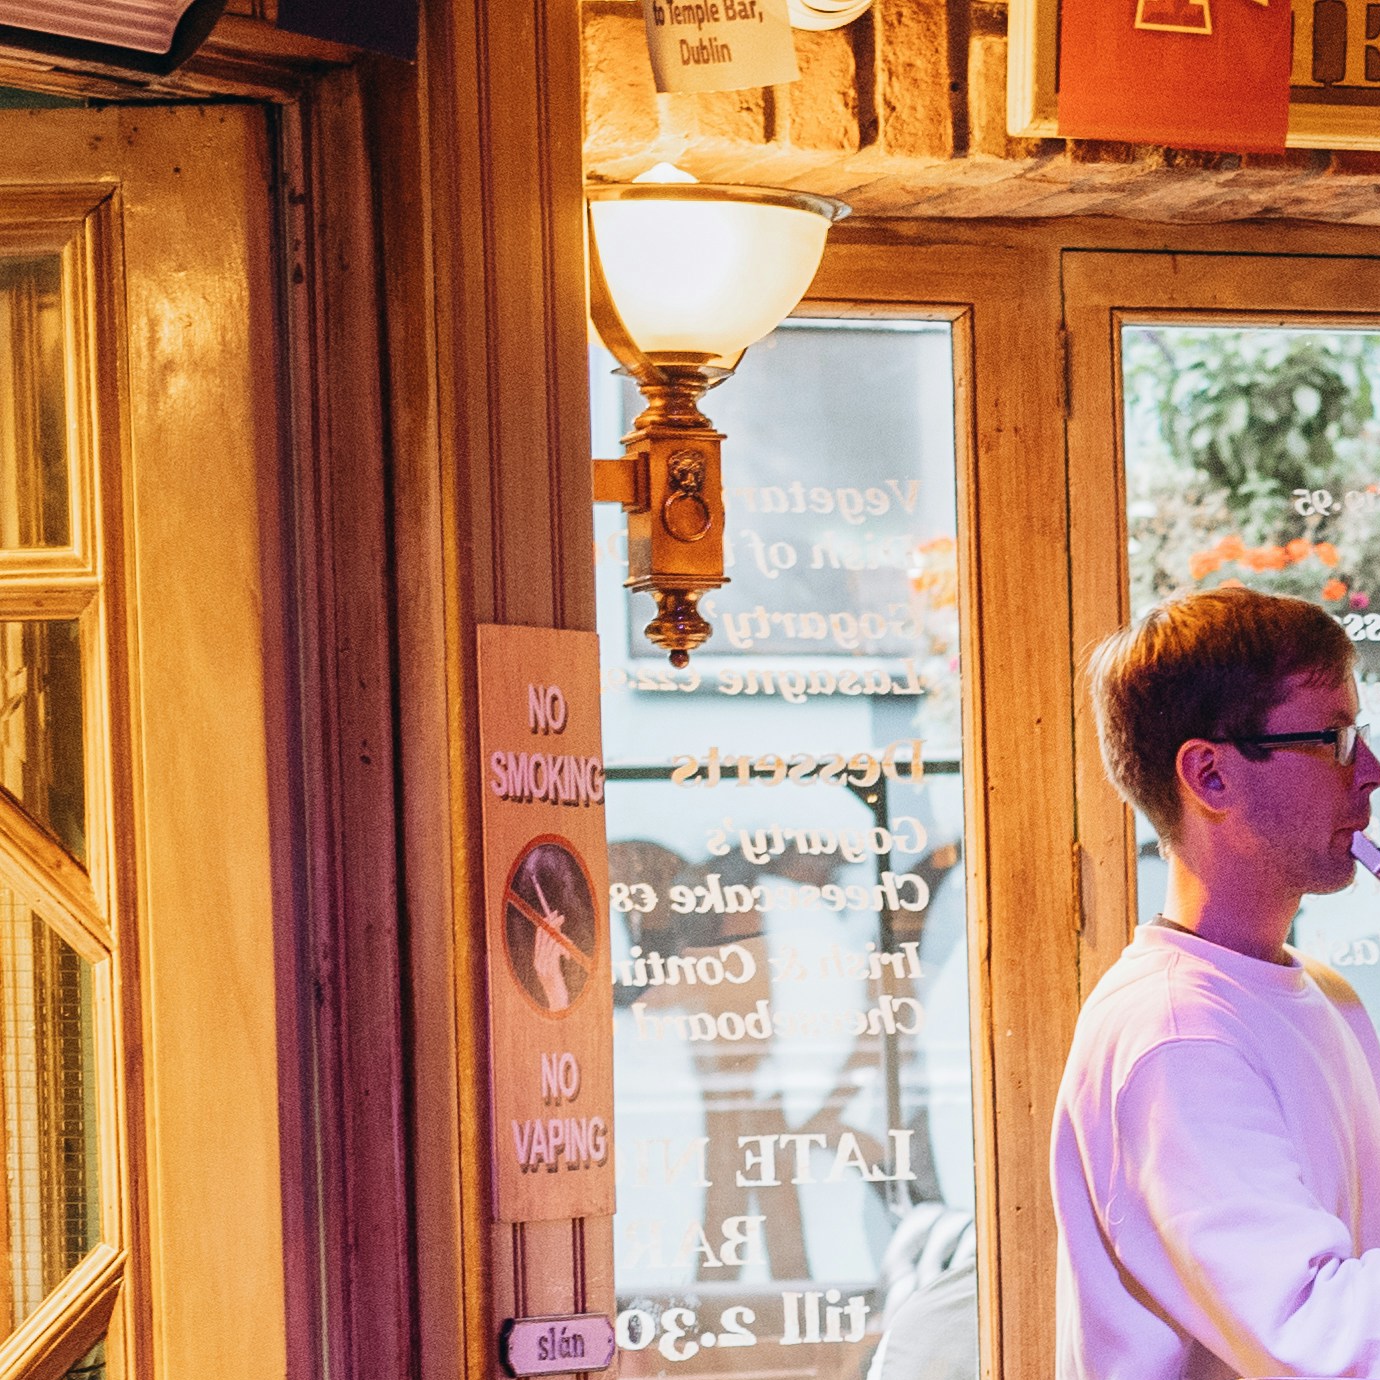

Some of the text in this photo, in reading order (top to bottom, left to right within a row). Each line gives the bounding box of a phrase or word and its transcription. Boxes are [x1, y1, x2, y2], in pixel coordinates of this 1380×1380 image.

[652, 0, 764, 31] to Temple Bar,
[679, 37, 733, 66] Dublin
[527, 683, 569, 737] NO
[488, 750, 605, 810] SMOKING
[539, 1051, 581, 1102] NO
[511, 1115, 609, 1177] VAPING
[537, 1323, 587, 1366] slán
